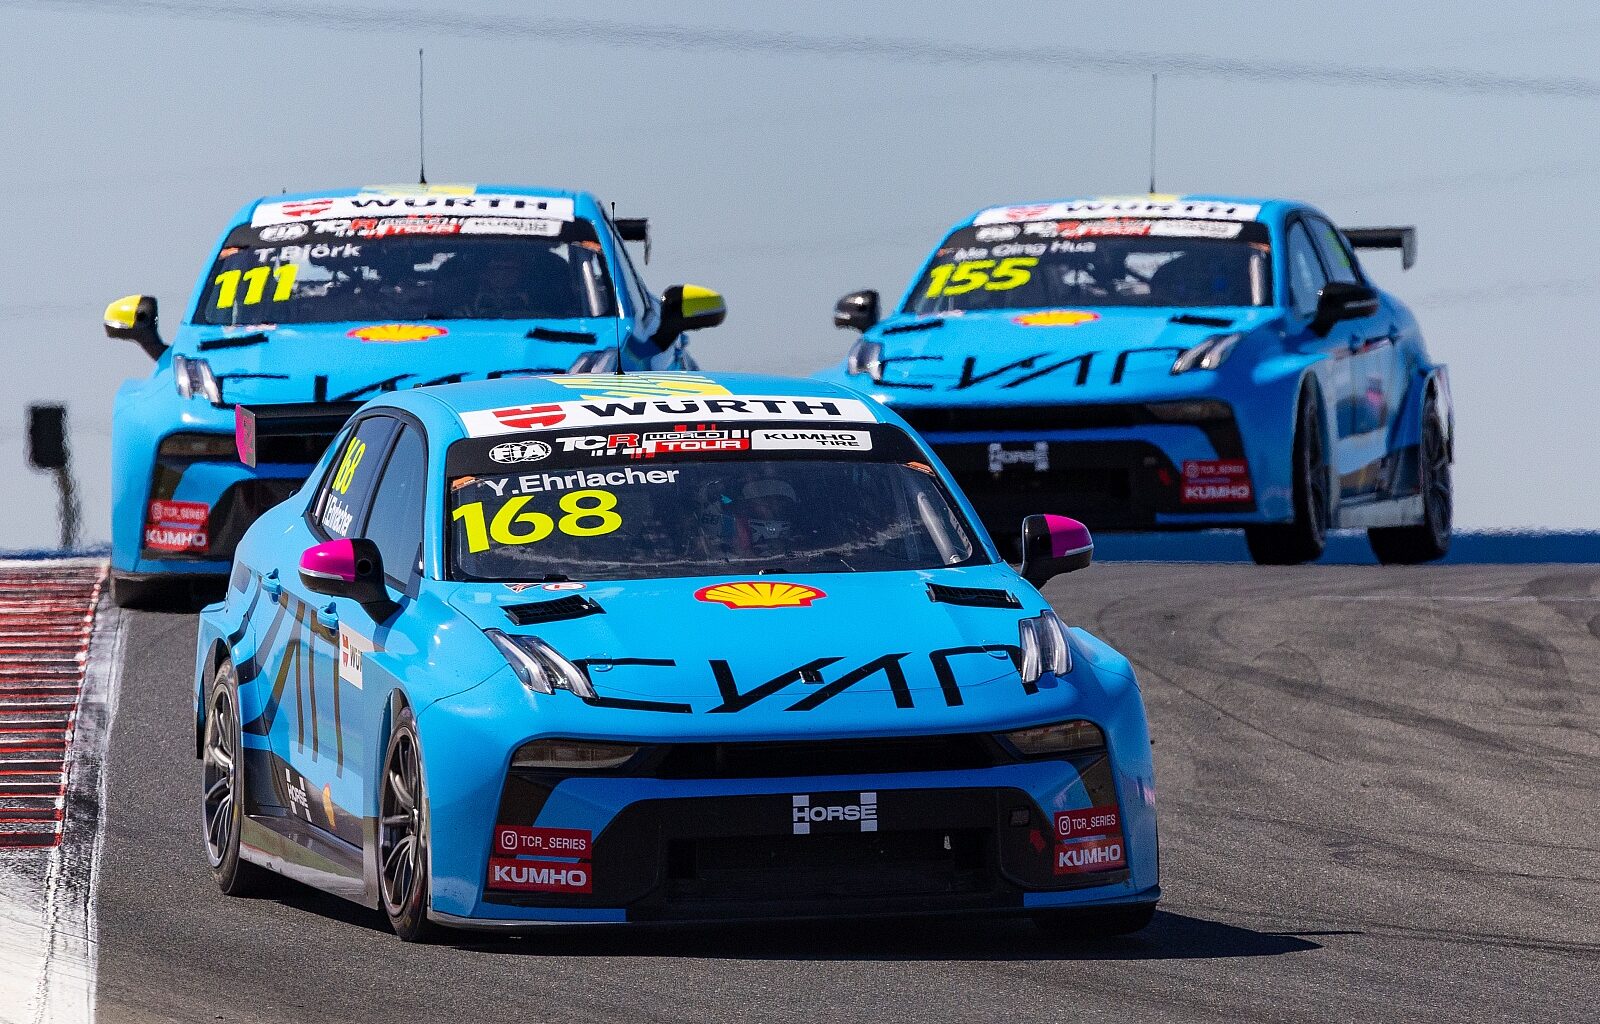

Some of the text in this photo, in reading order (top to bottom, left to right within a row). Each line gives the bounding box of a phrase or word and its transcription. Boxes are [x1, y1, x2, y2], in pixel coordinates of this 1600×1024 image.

[215, 264, 299, 309] 111
[925, 257, 1040, 298] 155
[581, 399, 842, 417] WÜRTH
[555, 433, 640, 452] TCR
[649, 432, 721, 440] WORLD
[661, 440, 741, 450] TOUR
[763, 433, 857, 441] KUMHO
[492, 443, 546, 461] FIA
[484, 467, 680, 497] Y.Ehrlacher
[452, 489, 623, 554] 168
[145, 529, 207, 547] KUMHO
[792, 804, 878, 822] HORSE
[1071, 814, 1117, 831] TCR_SERIES
[520, 835, 587, 851] TCR_SERIES
[1058, 844, 1121, 868] KUMHO
[494, 865, 587, 887] KUMHO
